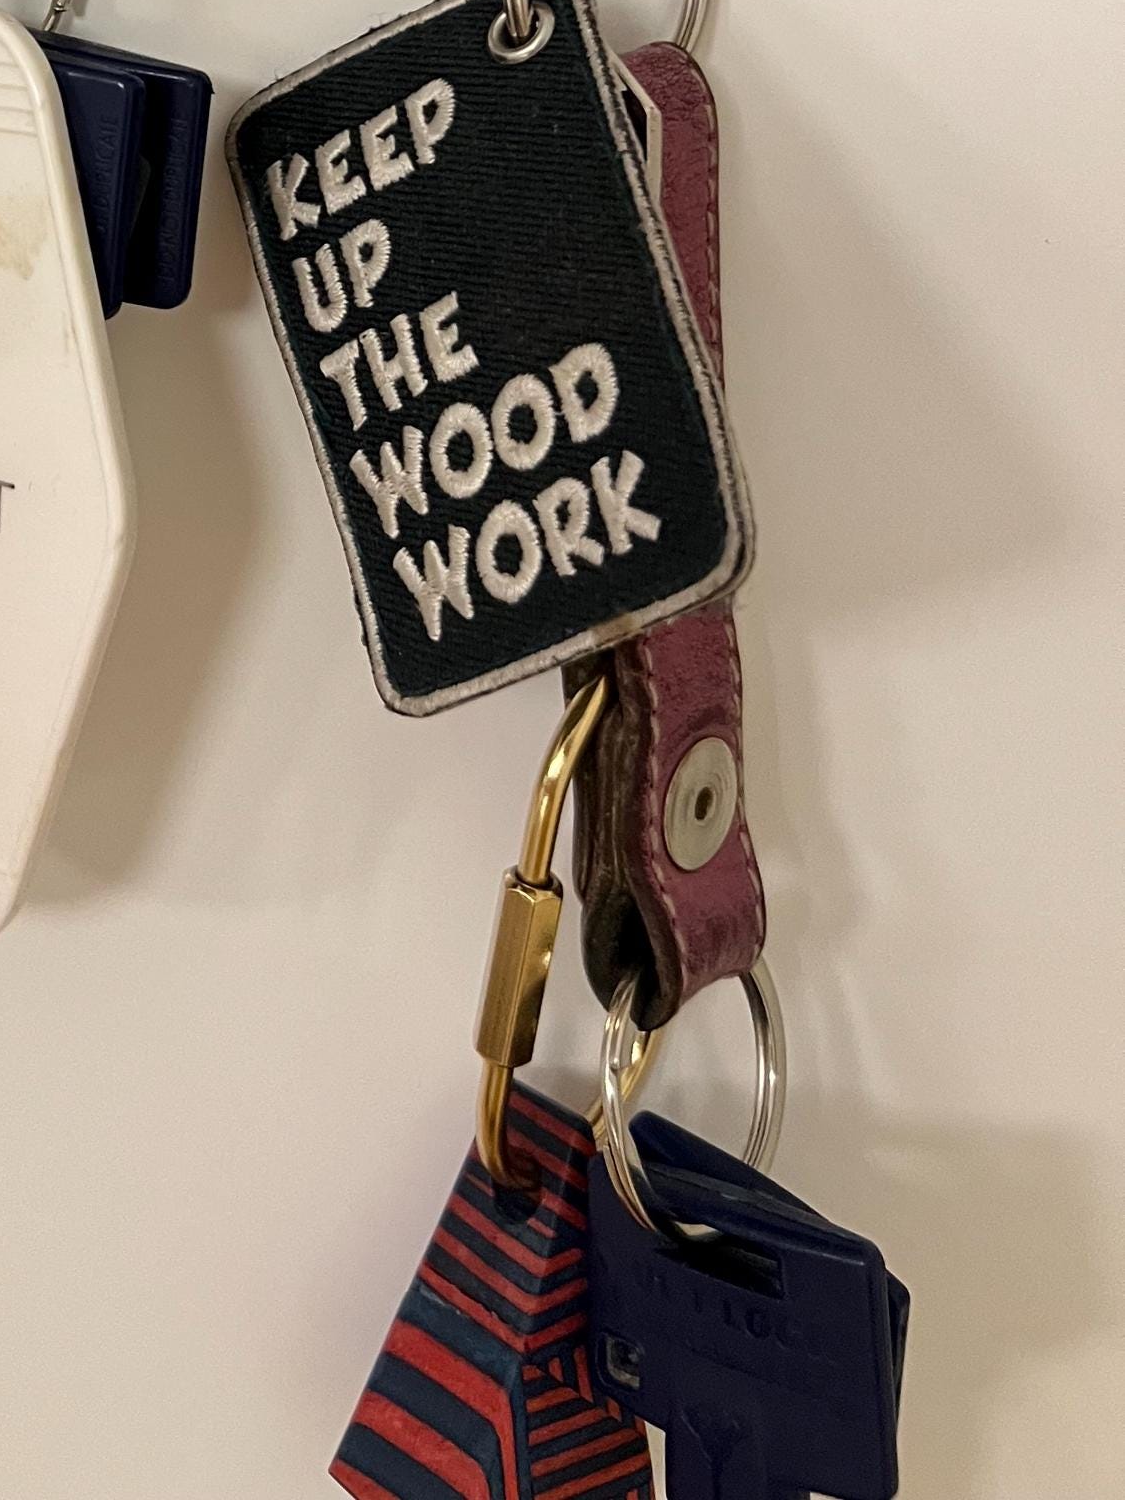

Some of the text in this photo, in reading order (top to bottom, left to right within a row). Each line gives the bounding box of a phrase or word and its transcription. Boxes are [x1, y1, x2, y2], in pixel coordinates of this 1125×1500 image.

[265, 78, 456, 241] KEEP
[291, 218, 392, 333] UP
[318, 291, 480, 431] THE
[349, 342, 620, 540] WOOD
[392, 450, 662, 641] WORK
